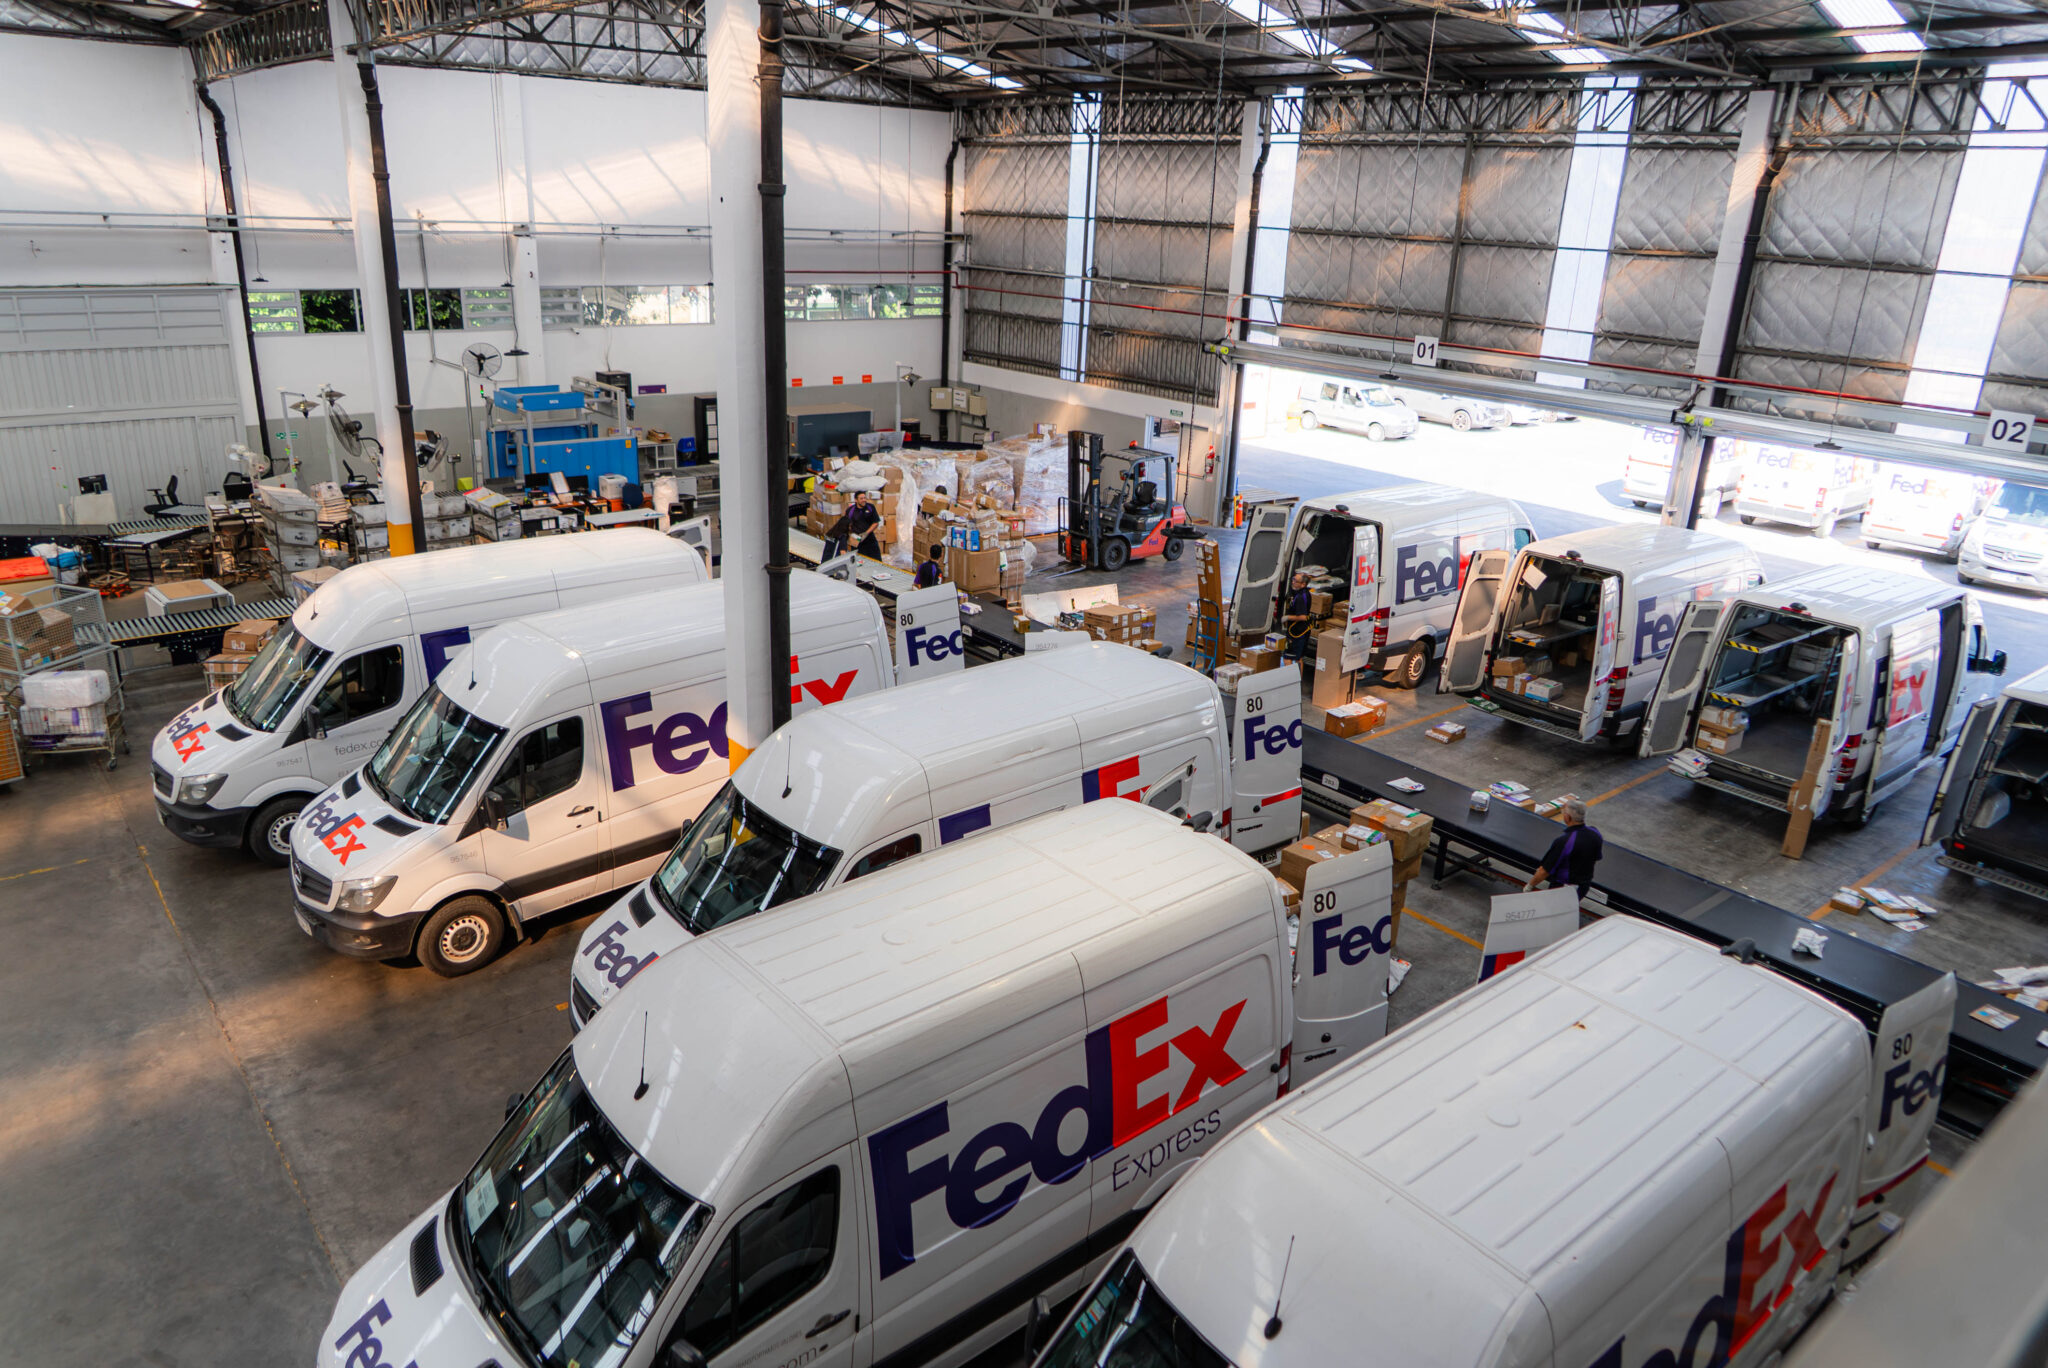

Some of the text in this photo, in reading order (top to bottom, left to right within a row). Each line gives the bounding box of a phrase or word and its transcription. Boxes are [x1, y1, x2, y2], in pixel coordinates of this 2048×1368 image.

[1417, 342, 1435, 360] 01
[1992, 418, 2027, 443] 02
[1757, 447, 1816, 472] FedEx
[1355, 555, 1375, 587] Ex
[1396, 536, 1475, 605] Fed
[900, 613, 914, 626] 80
[1246, 696, 1263, 713] 80
[335, 739, 384, 756] fedex.co
[300, 792, 367, 867] FedEx
[1313, 890, 1337, 914] 80
[582, 920, 660, 989] Fed
[1892, 1033, 1912, 1060] 80
[867, 995, 1248, 1280] FedEx
[1112, 1109, 1222, 1192] Express
